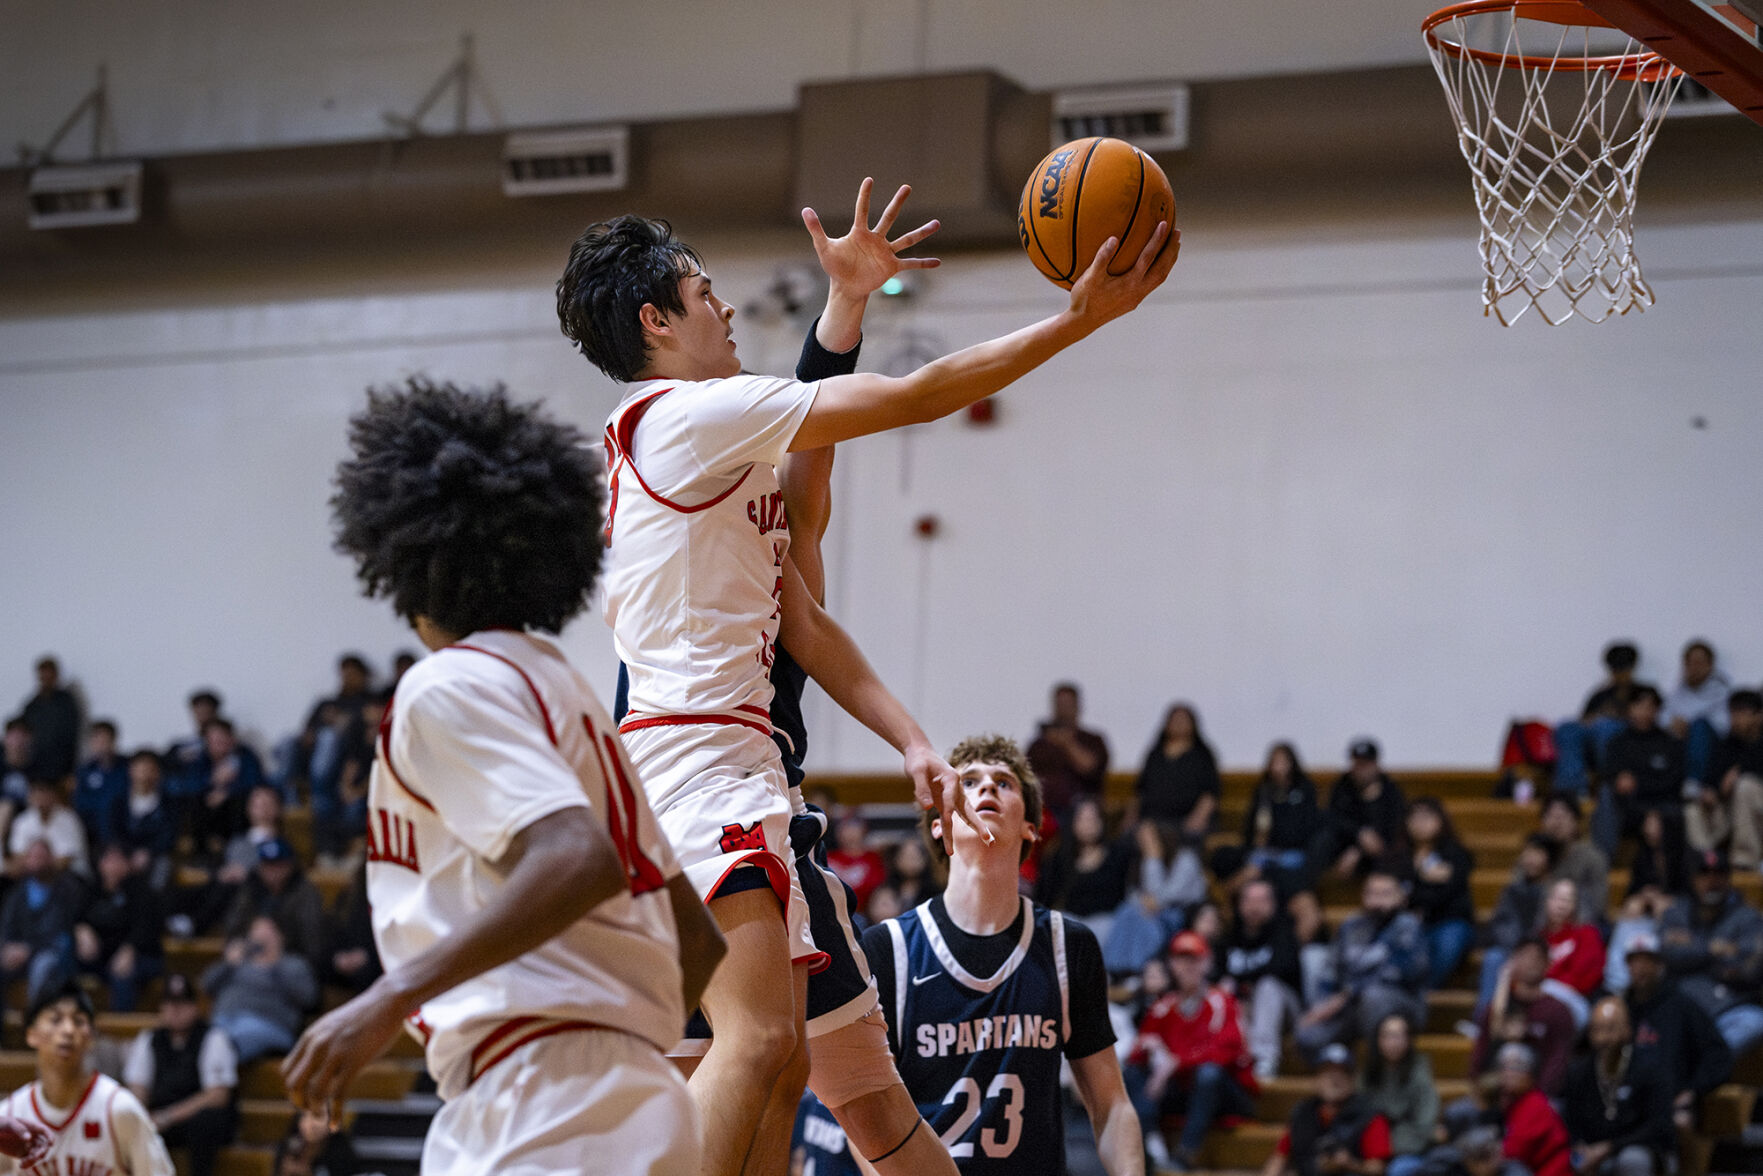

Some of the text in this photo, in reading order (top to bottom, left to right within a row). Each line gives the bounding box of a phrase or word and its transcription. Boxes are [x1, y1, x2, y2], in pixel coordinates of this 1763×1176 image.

[1040, 150, 1074, 219] NCAA
[916, 1014, 1058, 1058] SPARTANS
[940, 1073, 1025, 1158] 23
